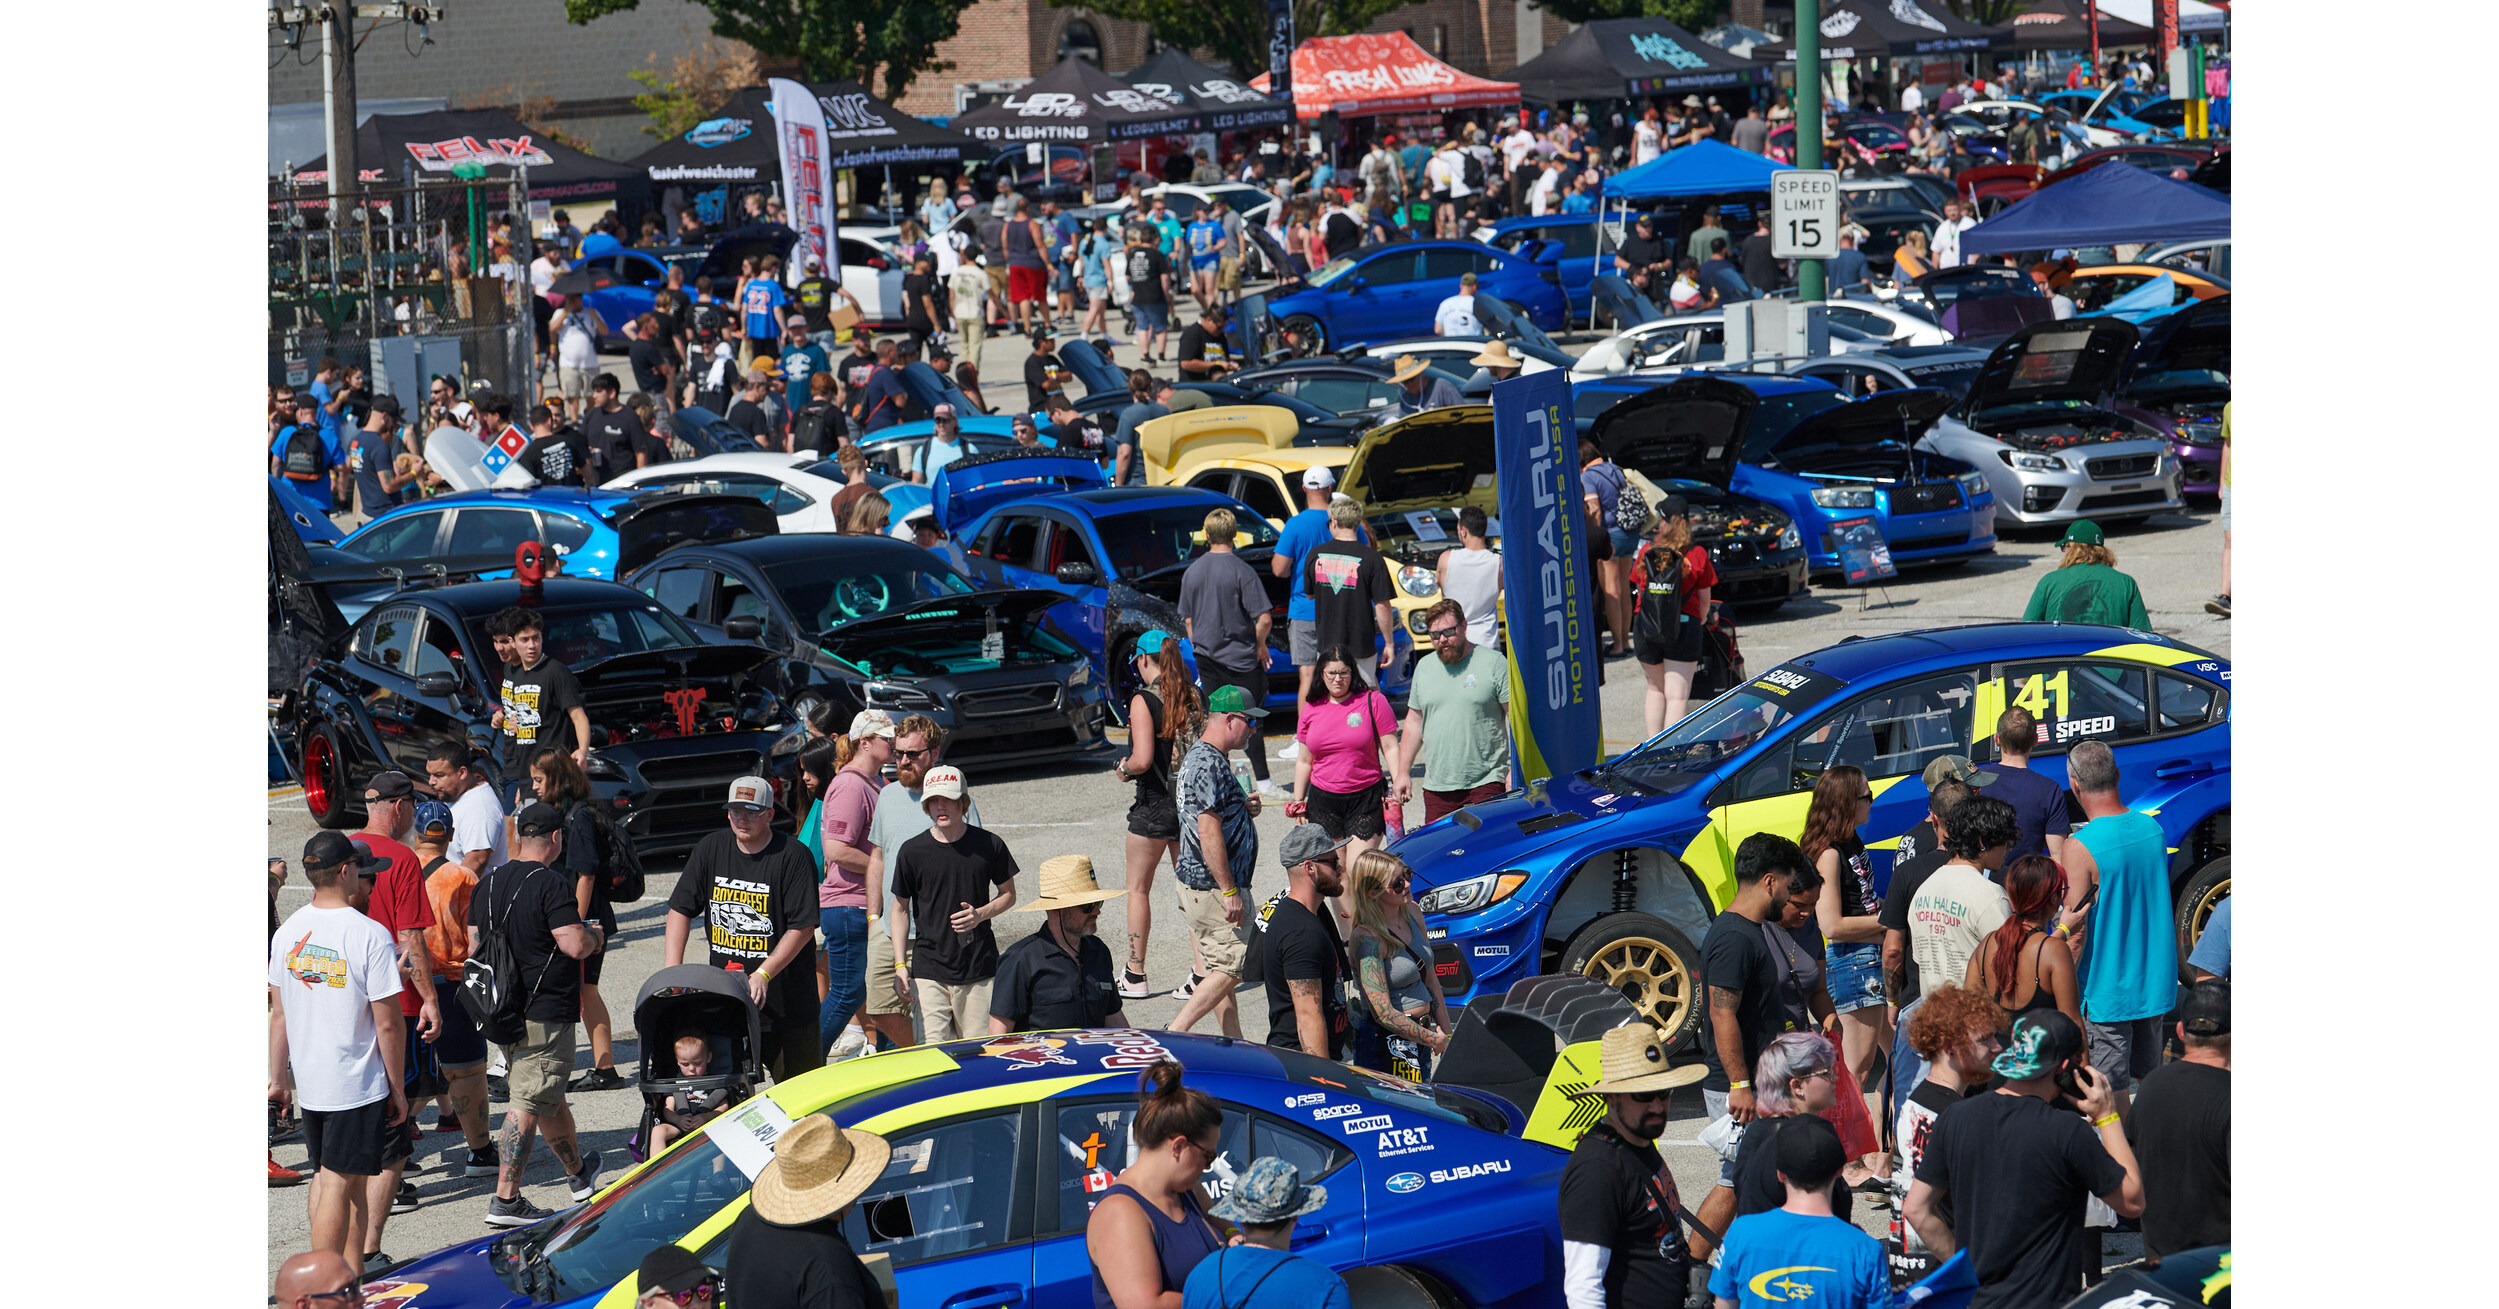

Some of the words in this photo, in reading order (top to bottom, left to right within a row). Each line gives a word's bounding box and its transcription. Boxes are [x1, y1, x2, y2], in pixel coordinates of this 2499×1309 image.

[1237, 110, 1288, 125] LIGHTING
[1005, 126, 1089, 139] LIGHTING
[405, 135, 546, 161] FELIX
[1779, 181, 1832, 193] SPEED
[1784, 199, 1825, 211] LIMIT
[1789, 219, 1821, 247] 15
[1549, 405, 1564, 465] USA
[1526, 408, 1568, 711] SUBARU
[1557, 473, 1583, 704] MOTORSPORTS
[1763, 669, 1811, 690] SUBARU
[2012, 670, 2069, 720] 41
[2056, 715, 2115, 739] SPEED
[1914, 896, 1931, 911] VAN
[1933, 896, 1967, 918] HALEN
[712, 926, 768, 951] BOXERFEST
[1426, 930, 1447, 939] HAMA
[1476, 947, 1508, 955] MOTUL
[287, 955, 347, 976] FACTORY
[1313, 1104, 1361, 1120] sparco
[1349, 1117, 1390, 1132] MOTUL
[1378, 1127, 1428, 1150] AT&T
[1379, 1148, 1407, 1158] Ethernet
[1408, 1144, 1434, 1154] Services
[1430, 1160, 1512, 1183] SUBARU
